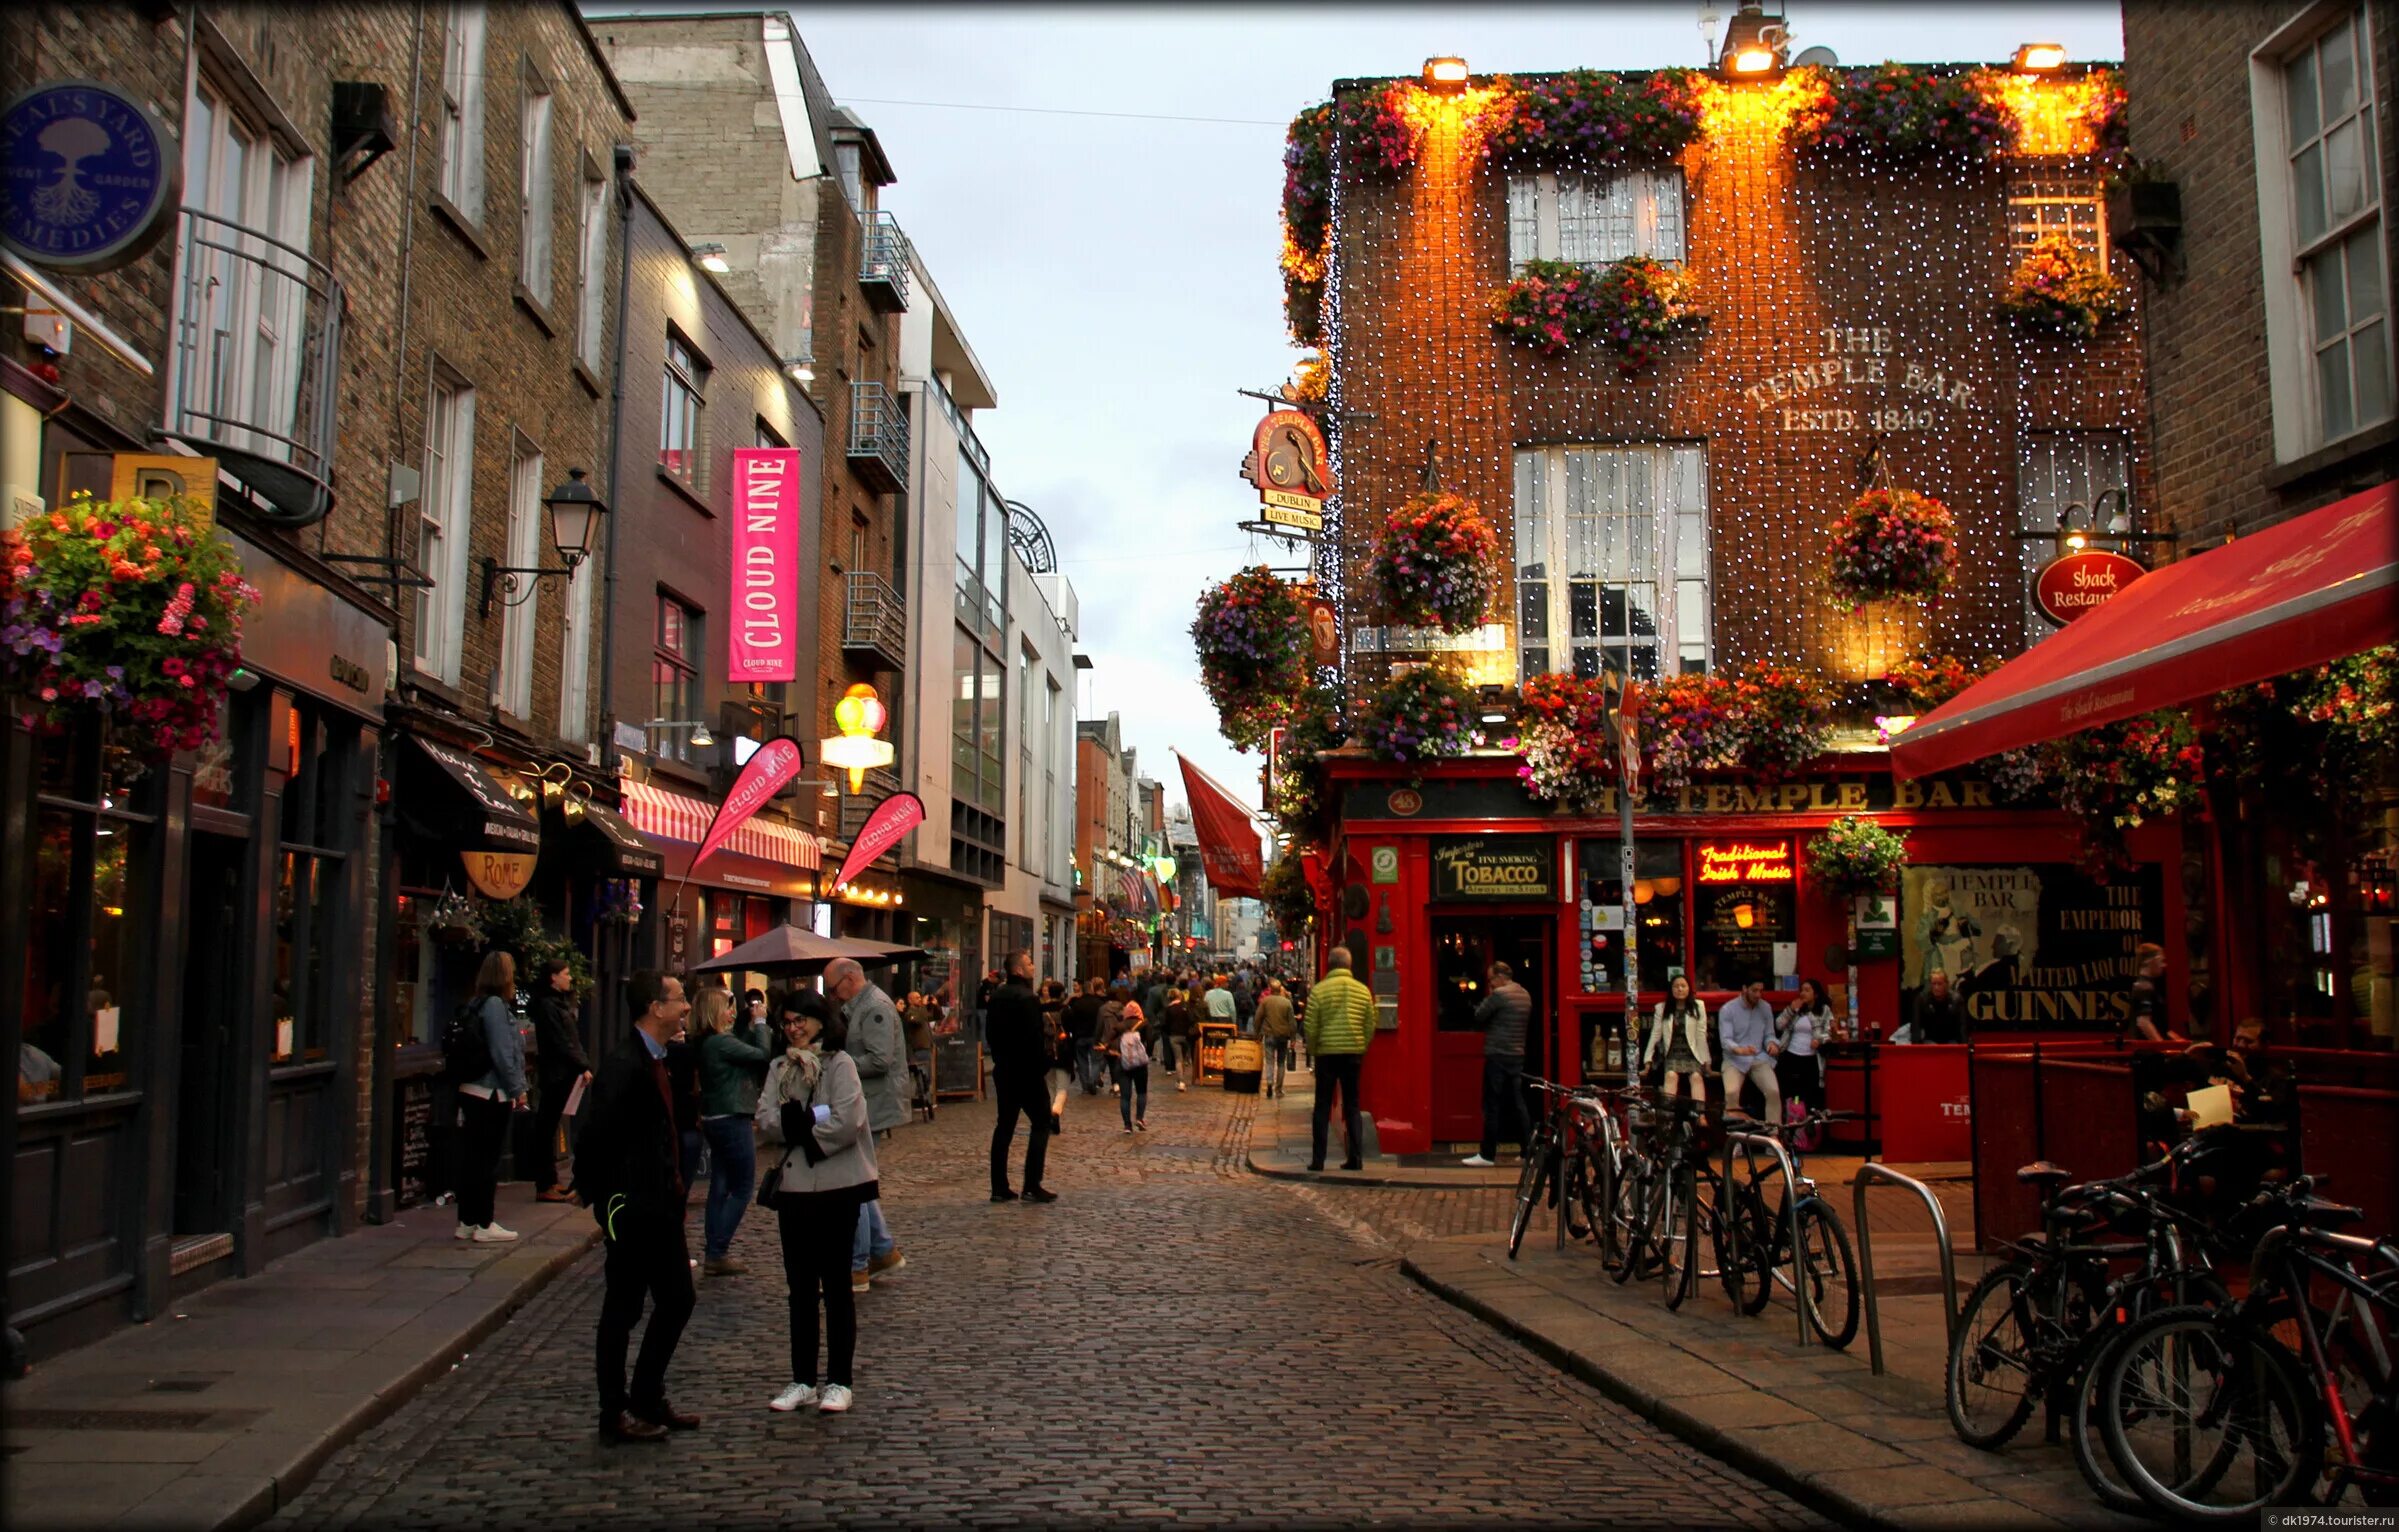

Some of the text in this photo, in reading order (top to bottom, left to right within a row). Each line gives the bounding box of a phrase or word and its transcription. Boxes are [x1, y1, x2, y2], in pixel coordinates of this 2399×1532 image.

[97, 99, 151, 168] YARD
[94, 173, 150, 188] GARDEN
[1825, 328, 1892, 353] THE
[1744, 358, 1974, 410] TEMPLE BAR
[1784, 409, 1934, 432] ESTD. 1840
[1261, 413, 1324, 466] THE TEMPLE BAR
[747, 459, 786, 534] NINE
[1276, 493, 1311, 509] DUBLIN
[1270, 510, 1318, 527] LIVE MUSIC
[2073, 563, 2118, 590] Shack
[744, 545, 782, 649] CLOUD
[743, 658, 783, 669] CLOUD NINE
[728, 776, 766, 815] CLOUD
[765, 746, 794, 778] NINE
[1394, 794, 1415, 809] 48
[1676, 783, 1868, 813] TEMPLE
[1893, 780, 1993, 808] BAR
[860, 801, 916, 851] CLOUD NINE
[1478, 856, 1498, 864] FINE
[1701, 841, 1787, 863] Traditional
[1700, 862, 1792, 881] Irish Music
[1949, 875, 2034, 890] TEMPLE
[1974, 892, 2016, 908] BAR
[2106, 886, 2143, 906] THE
[2059, 909, 2143, 930] EMPEROR
[2009, 963, 2078, 988] MALTED
[1967, 990, 2132, 1022] GUINNES
